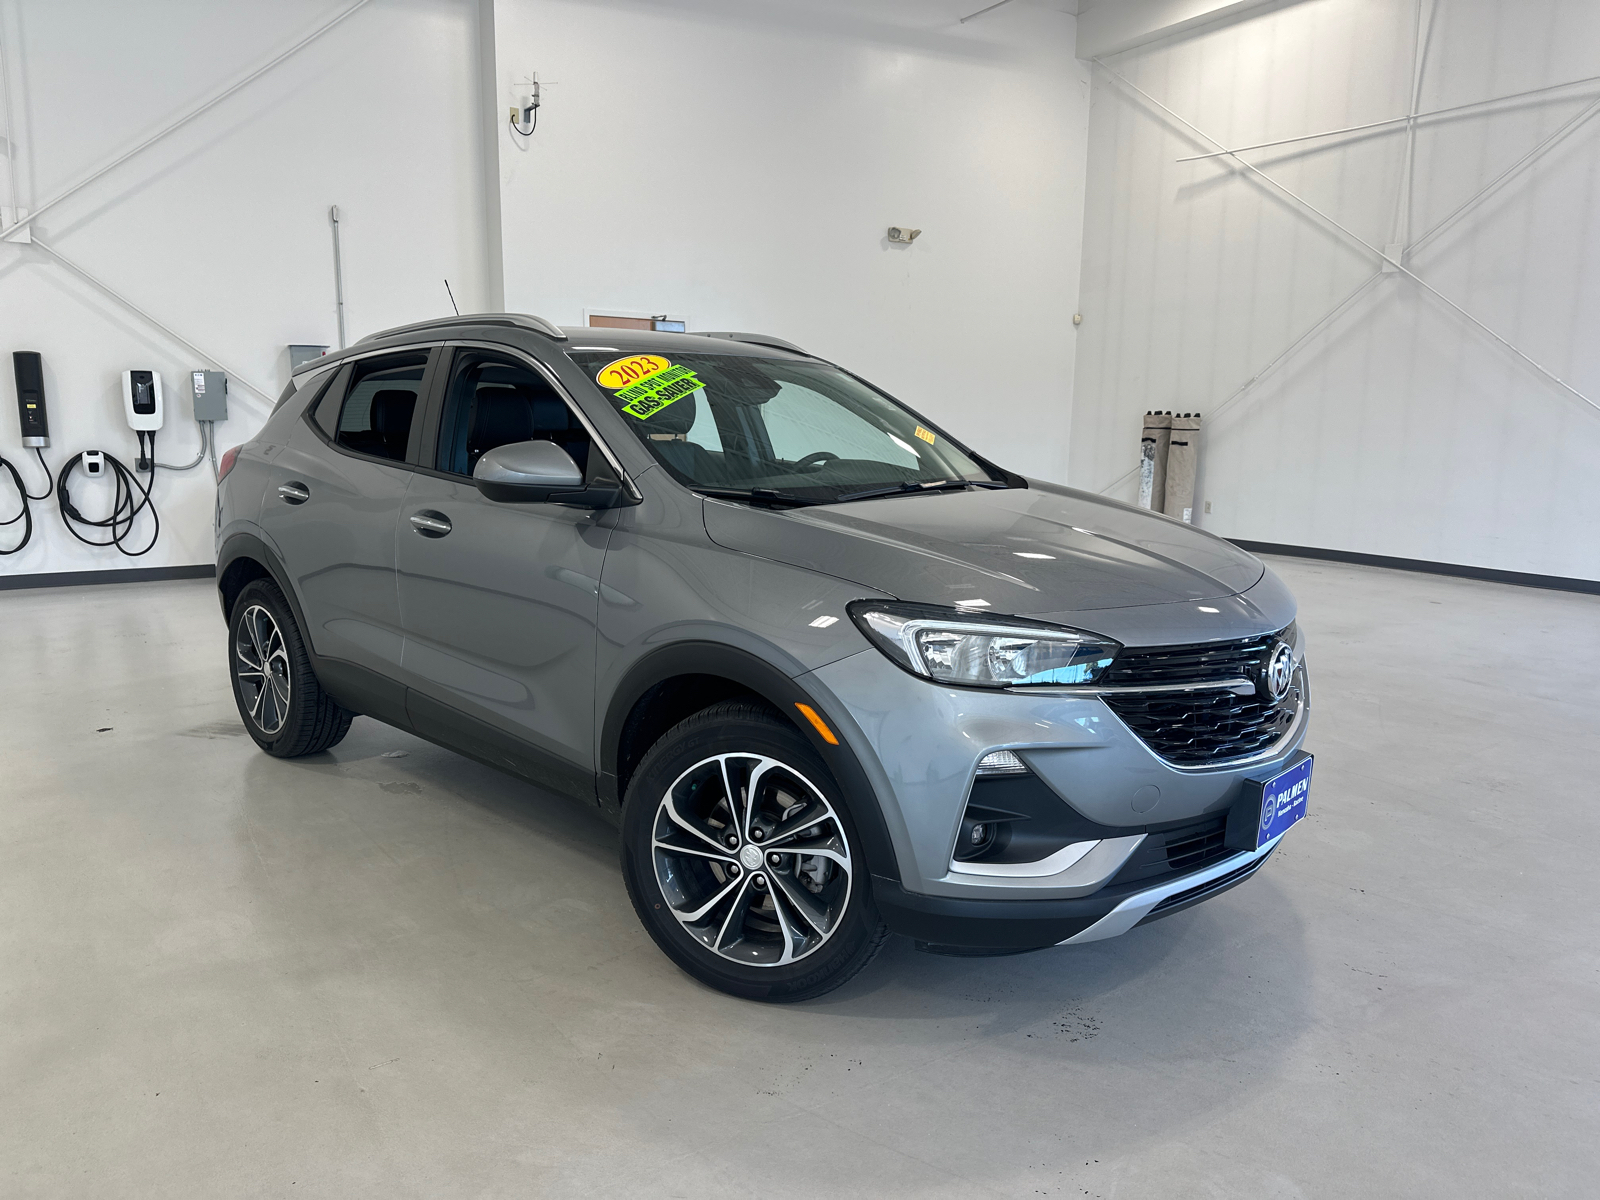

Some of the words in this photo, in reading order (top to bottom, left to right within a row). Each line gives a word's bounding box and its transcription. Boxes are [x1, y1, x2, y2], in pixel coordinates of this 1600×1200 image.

[610, 357, 659, 386] 2023
[618, 385, 648, 402] BLIND
[640, 377, 665, 391] SPOT
[629, 377, 701, 416] GAS-SAVER
[1276, 777, 1308, 809] PALMEN
